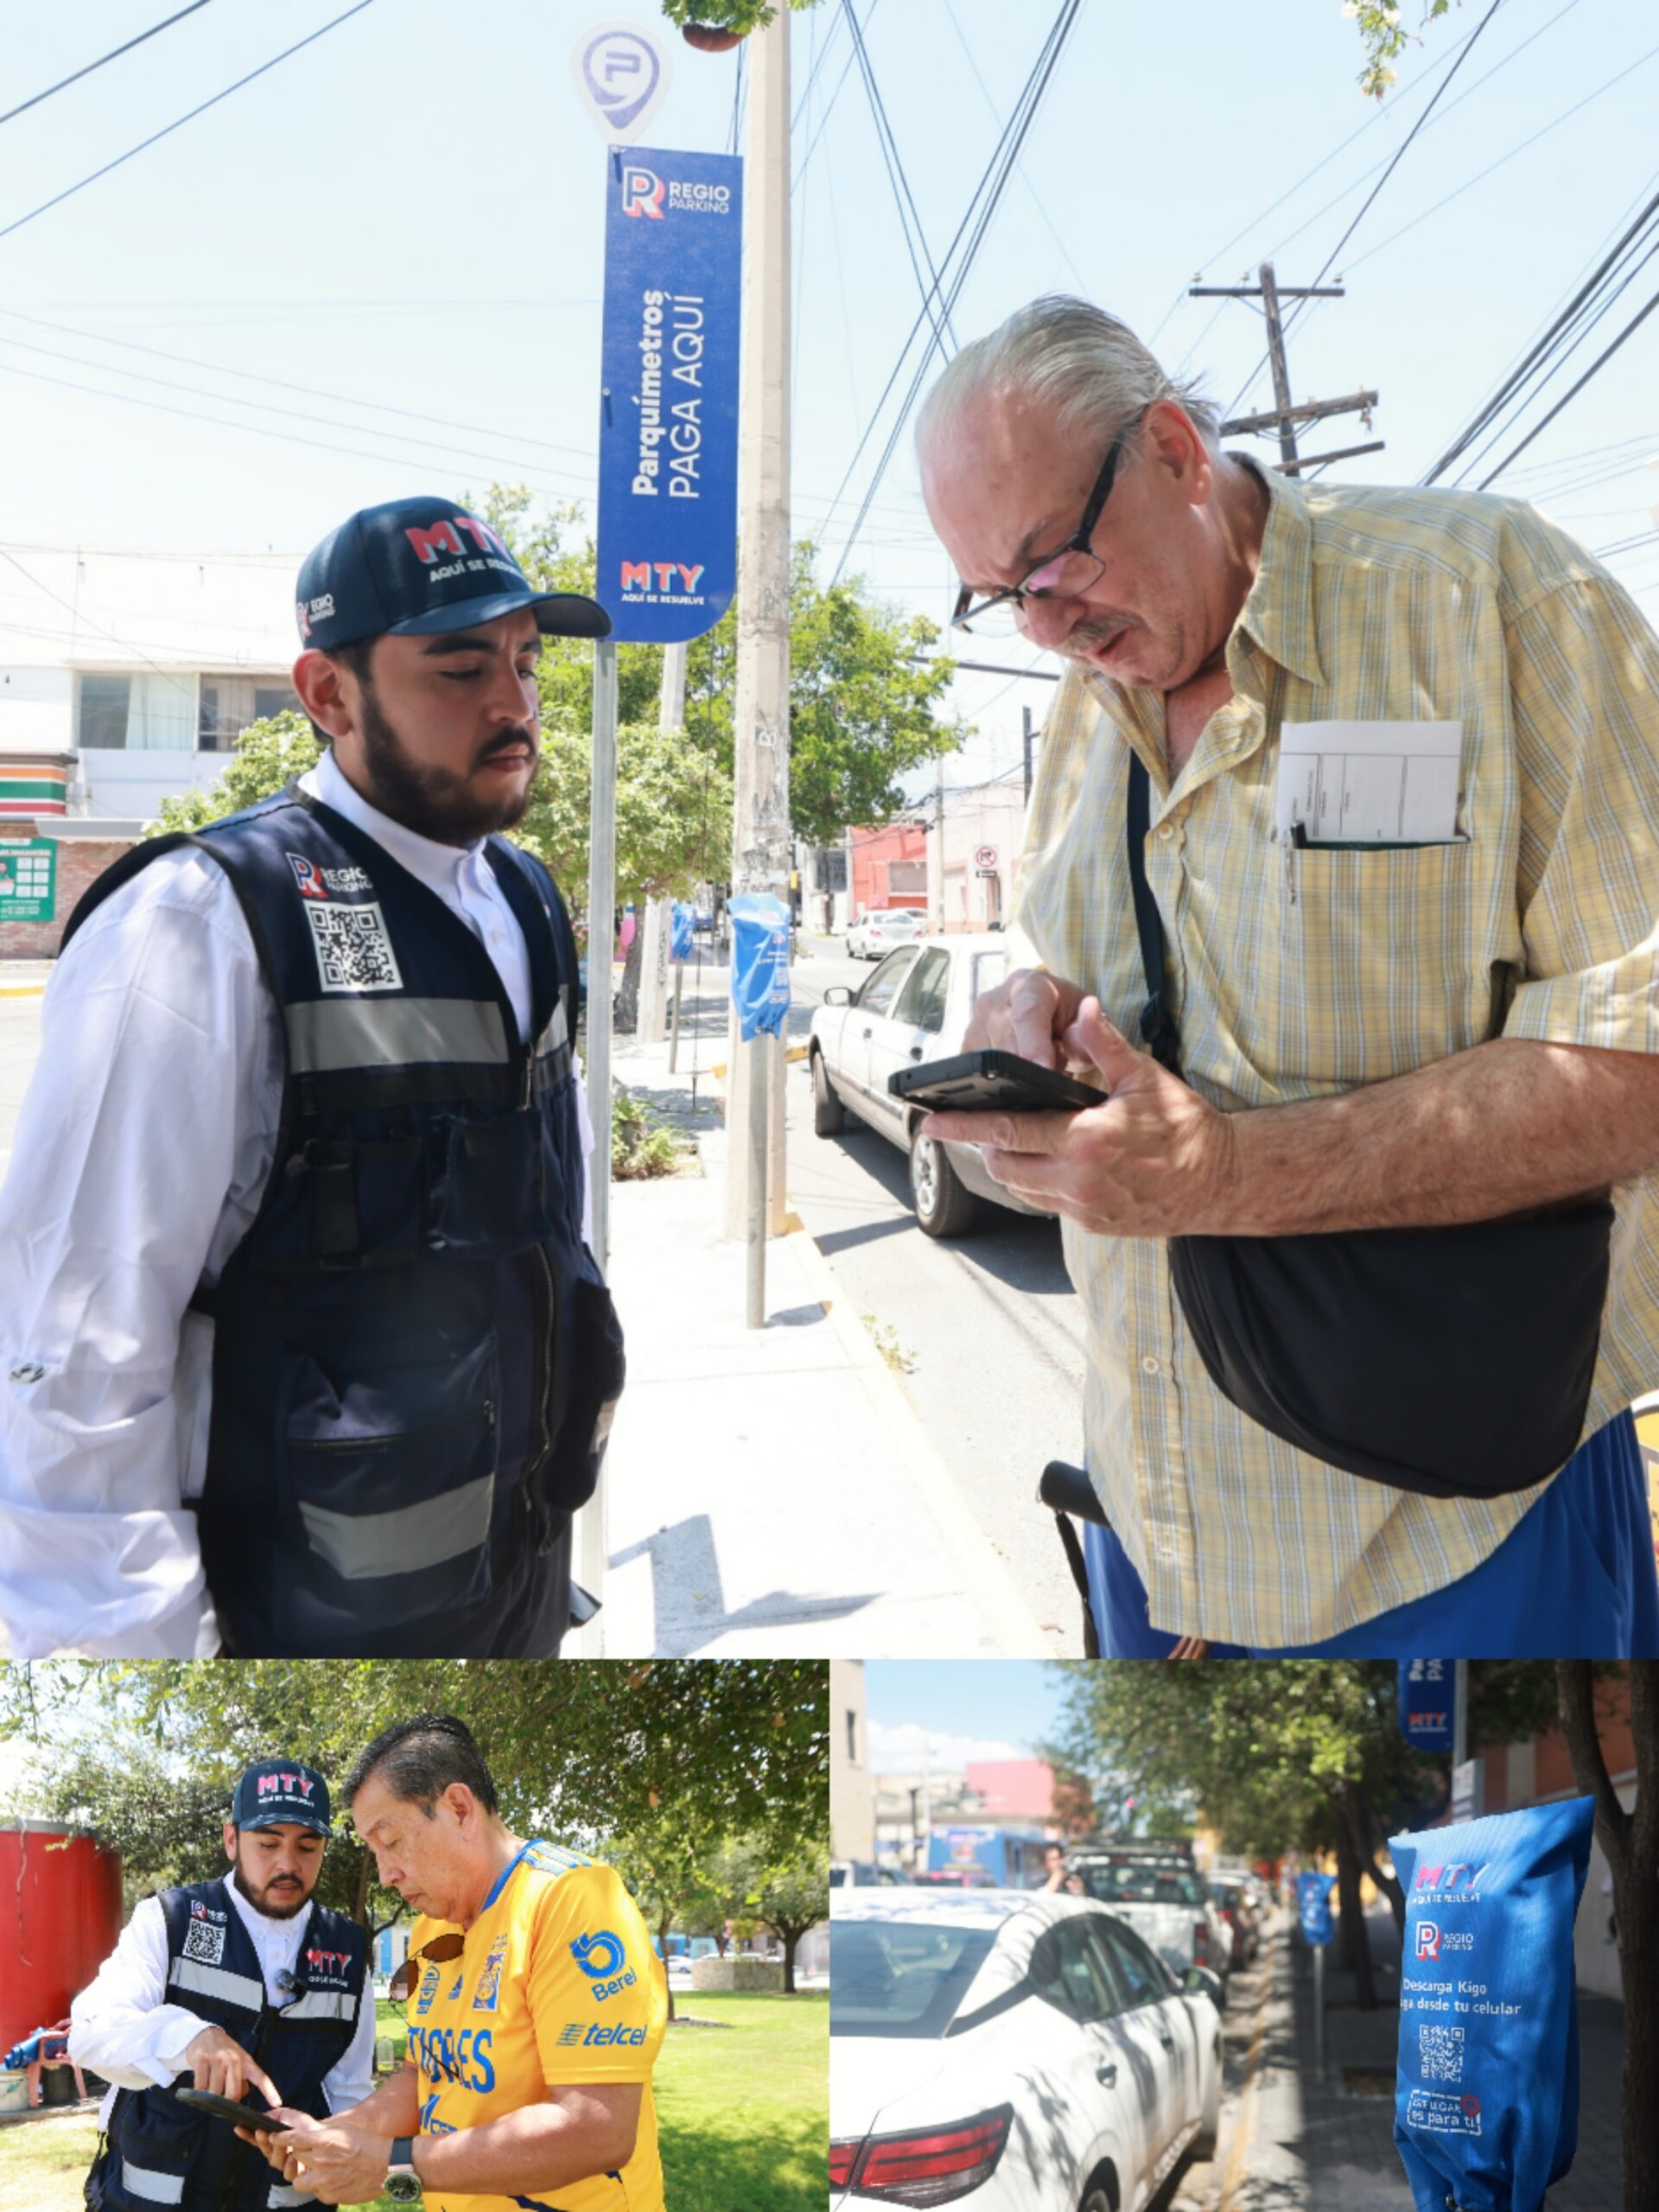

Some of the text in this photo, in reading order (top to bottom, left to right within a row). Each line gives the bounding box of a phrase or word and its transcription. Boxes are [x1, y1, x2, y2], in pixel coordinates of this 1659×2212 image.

[669, 181, 731, 202] REGIO
[669, 198, 730, 213] PARKING
[632, 289, 666, 497] Parquímetros
[664, 292, 704, 499] PAGA AQUÍ
[429, 559, 466, 583] AQUÍ
[467, 559, 486, 571] SE
[620, 562, 706, 594] MTY
[621, 593, 705, 606] AQUÍ SE RESUELVE
[1408, 1712, 1446, 1727] MTY
[257, 1772, 315, 1798] MTY
[1414, 1863, 1491, 1891] MTY
[591, 1966, 638, 2002] Berel
[1403, 1978, 1487, 1997] Descarga Kigo
[1417, 1997, 1450, 2011] desde
[1454, 2000, 1469, 2012] tu
[1472, 2000, 1522, 2015] celular
[582, 2022, 648, 2046] telcel
[1428, 2112, 1460, 2127] para
